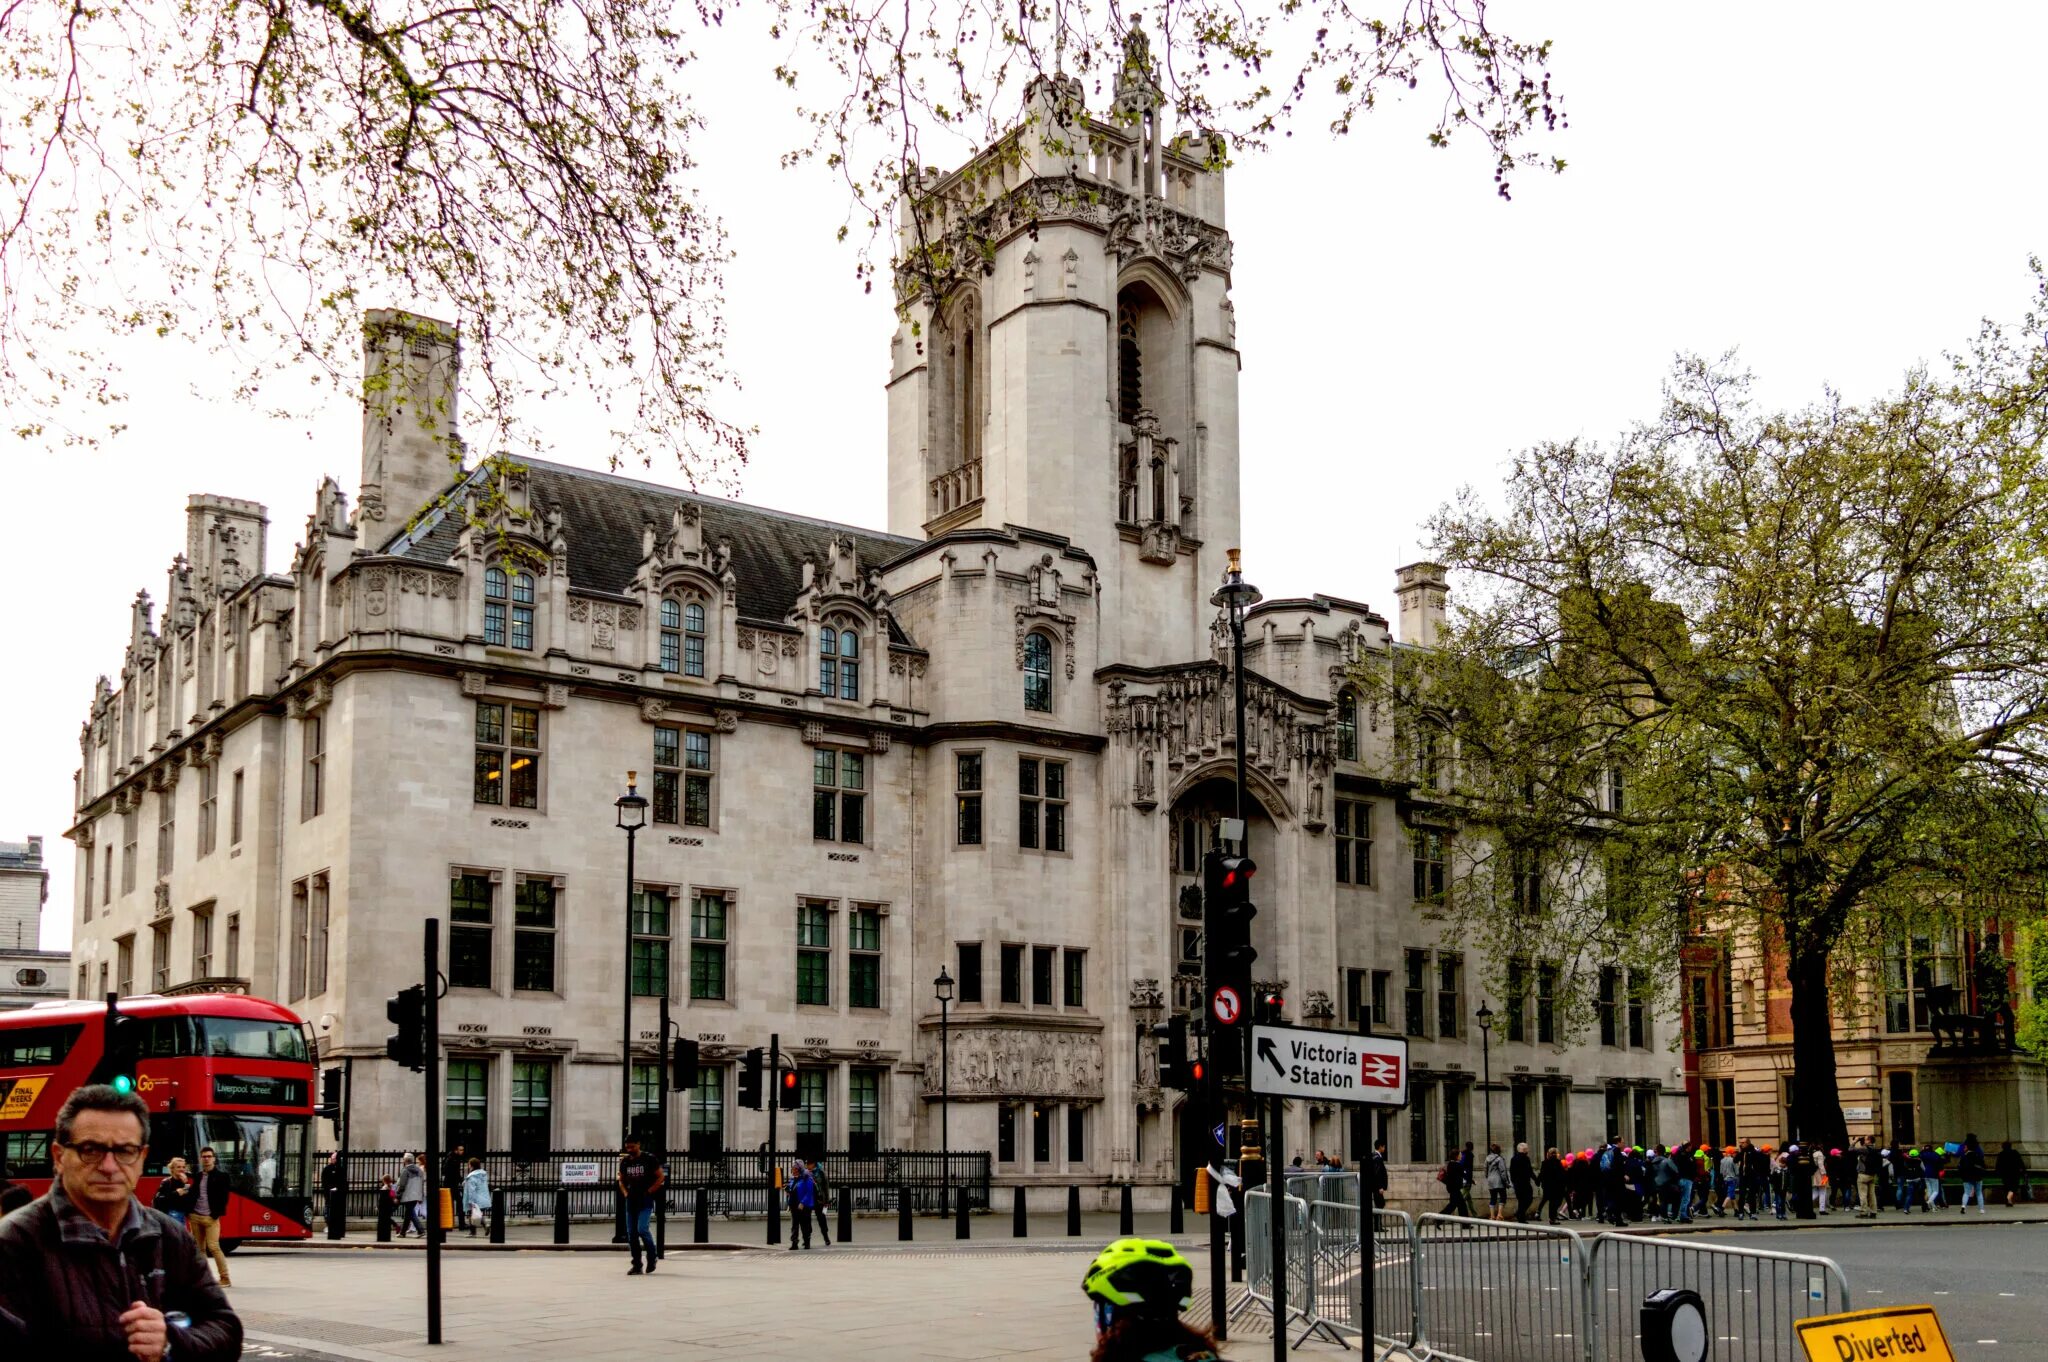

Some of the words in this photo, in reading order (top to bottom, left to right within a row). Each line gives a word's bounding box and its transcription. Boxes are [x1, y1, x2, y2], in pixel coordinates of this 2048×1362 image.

[1290, 1040, 1357, 1065] Victoria
[1290, 1064, 1353, 1088] Station
[10, 1095, 33, 1103] WEEKS
[217, 1083, 248, 1095] Liverpool
[250, 1085, 272, 1095] Street
[284, 1084, 295, 1101] 11
[1833, 1324, 1927, 1362] Diverted
